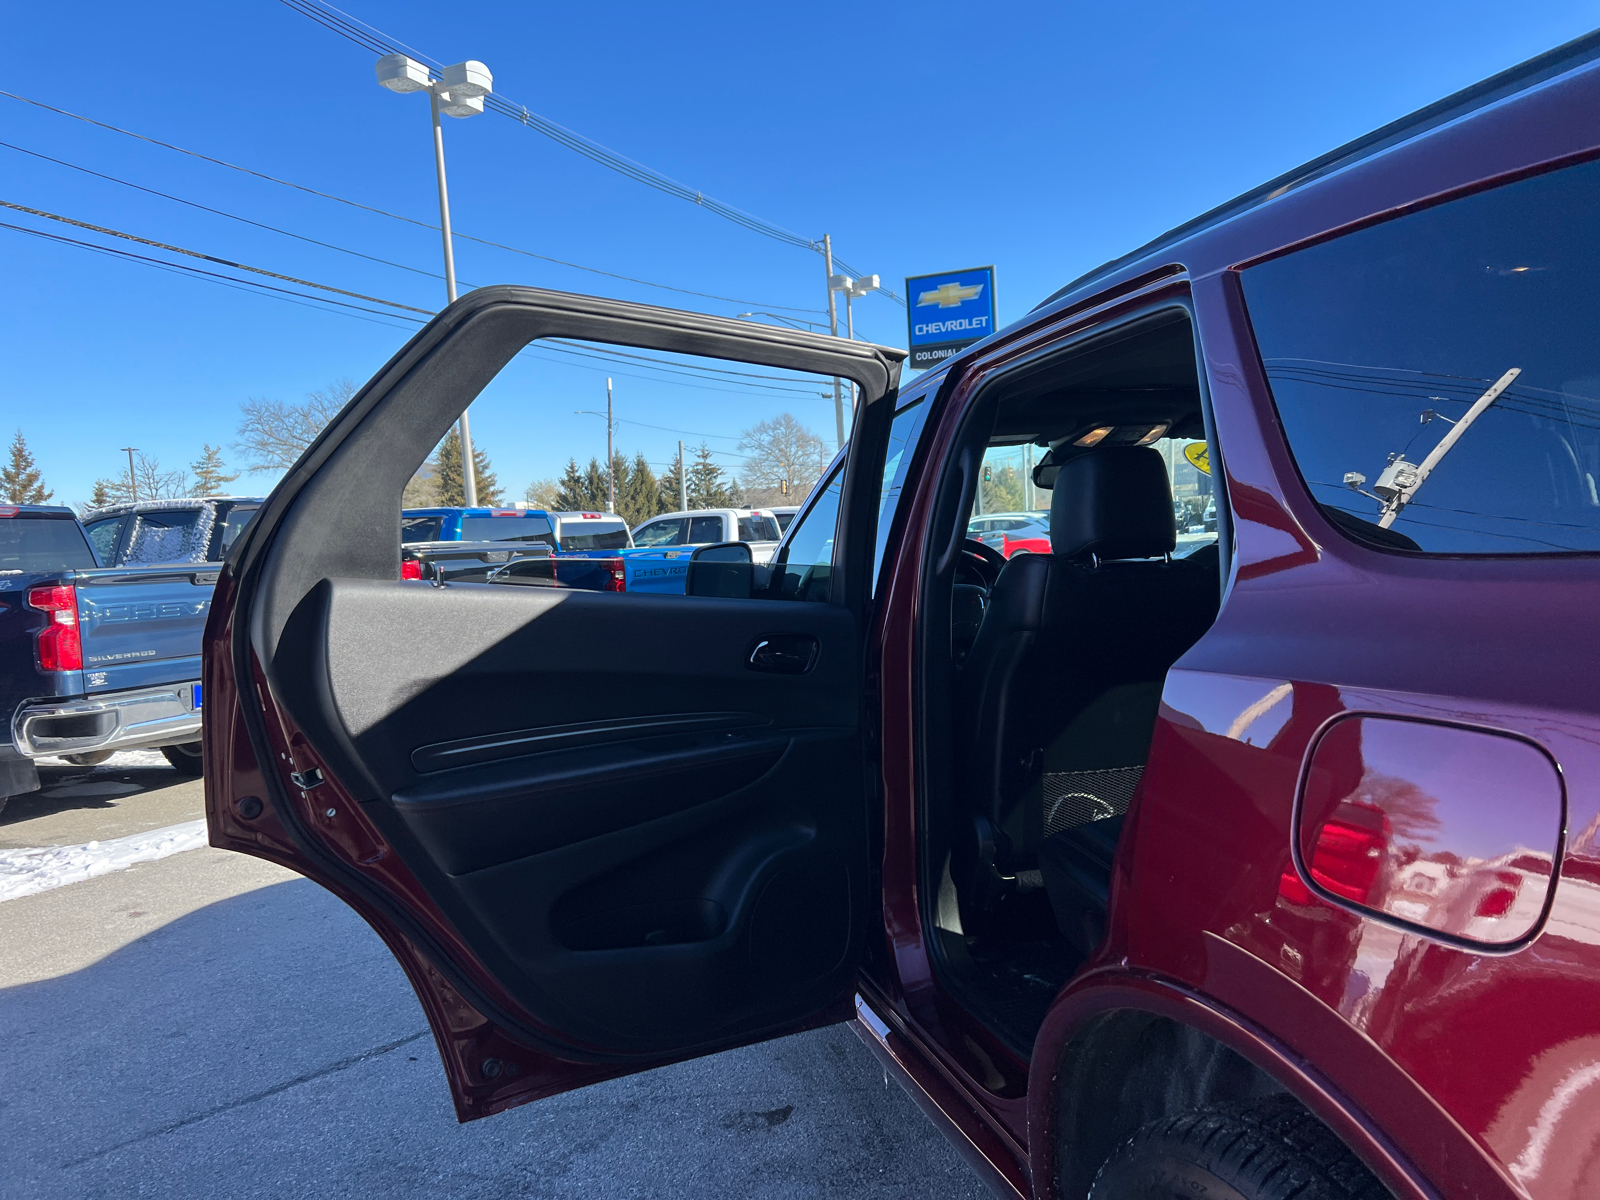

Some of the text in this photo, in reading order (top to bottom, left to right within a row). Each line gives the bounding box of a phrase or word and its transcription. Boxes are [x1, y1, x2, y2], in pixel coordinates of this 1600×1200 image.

[915, 316, 988, 335] CHEVROLET
[103, 600, 208, 622] CHEV
[89, 650, 156, 662] SILVERADO
